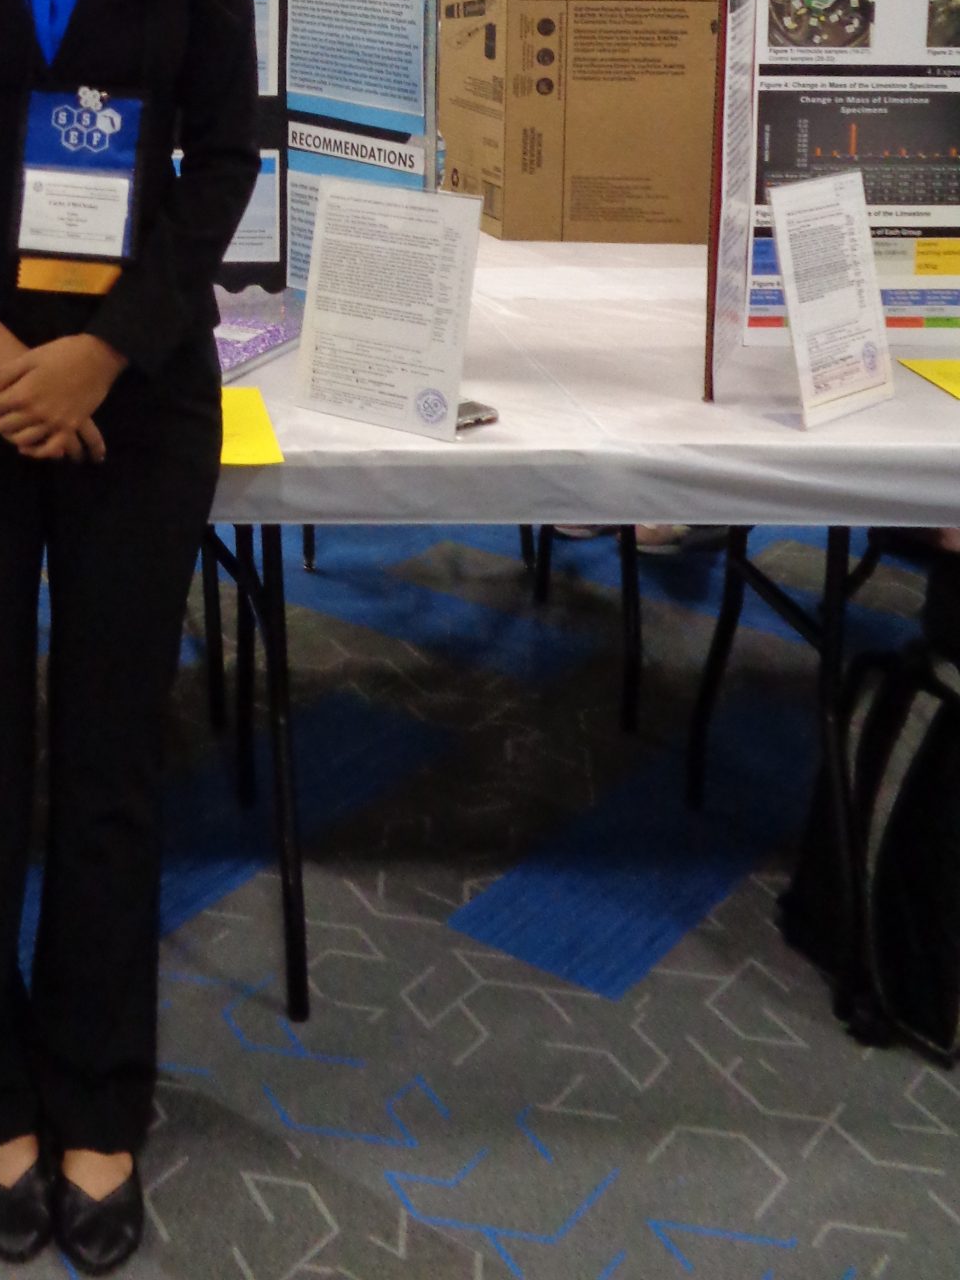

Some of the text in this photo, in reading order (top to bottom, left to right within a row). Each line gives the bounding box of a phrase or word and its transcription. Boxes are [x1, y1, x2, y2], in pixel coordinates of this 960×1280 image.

[760, 82, 783, 90] Figure
[792, 82, 818, 90] Change
[871, 82, 907, 90] Limestone
[800, 96, 930, 105] Change in Mass of Limestone
[840, 107, 888, 115] Specimens
[291, 129, 416, 170] RECOMMENDATIONS
